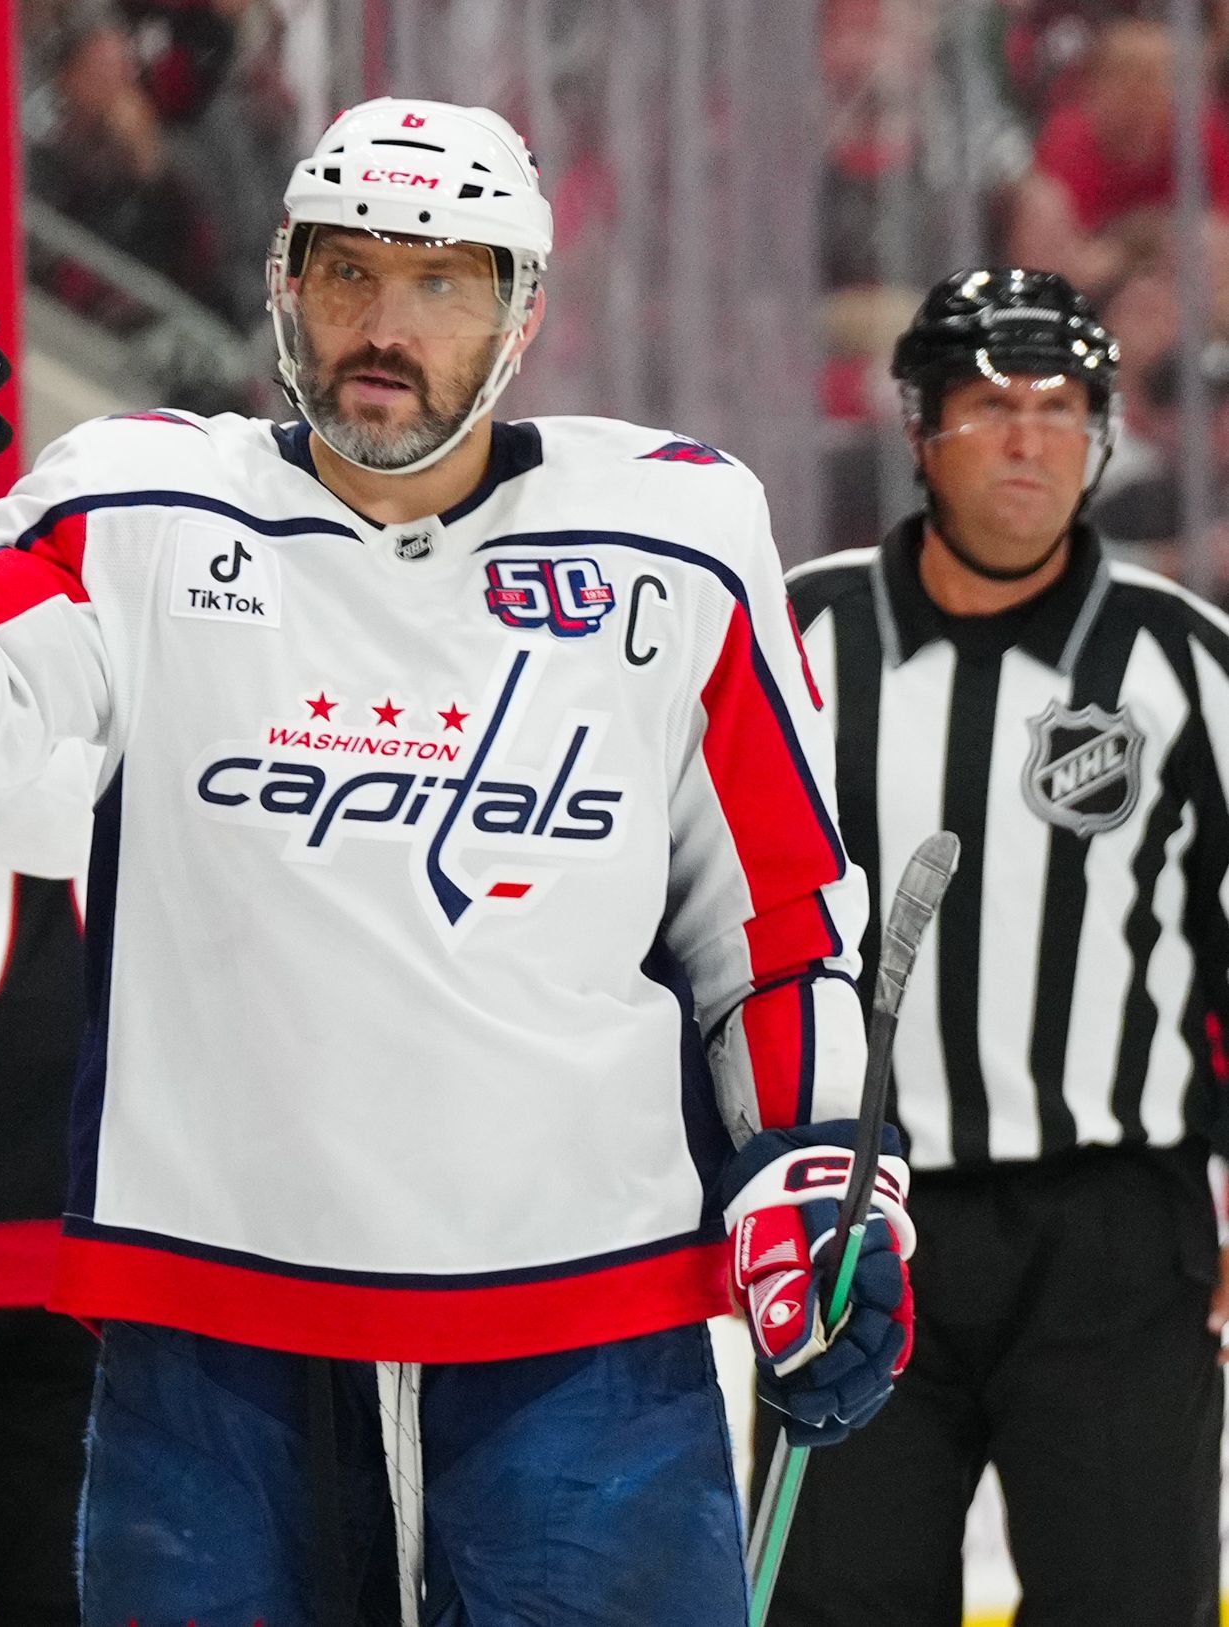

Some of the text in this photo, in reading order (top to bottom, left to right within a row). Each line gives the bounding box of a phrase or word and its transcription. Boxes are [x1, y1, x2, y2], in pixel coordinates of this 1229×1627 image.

[362, 169, 439, 189] CCM
[187, 588, 265, 616] TikTok
[625, 575, 667, 666] C
[269, 726, 461, 762] WASHINGTON
[1051, 737, 1125, 801] NHL
